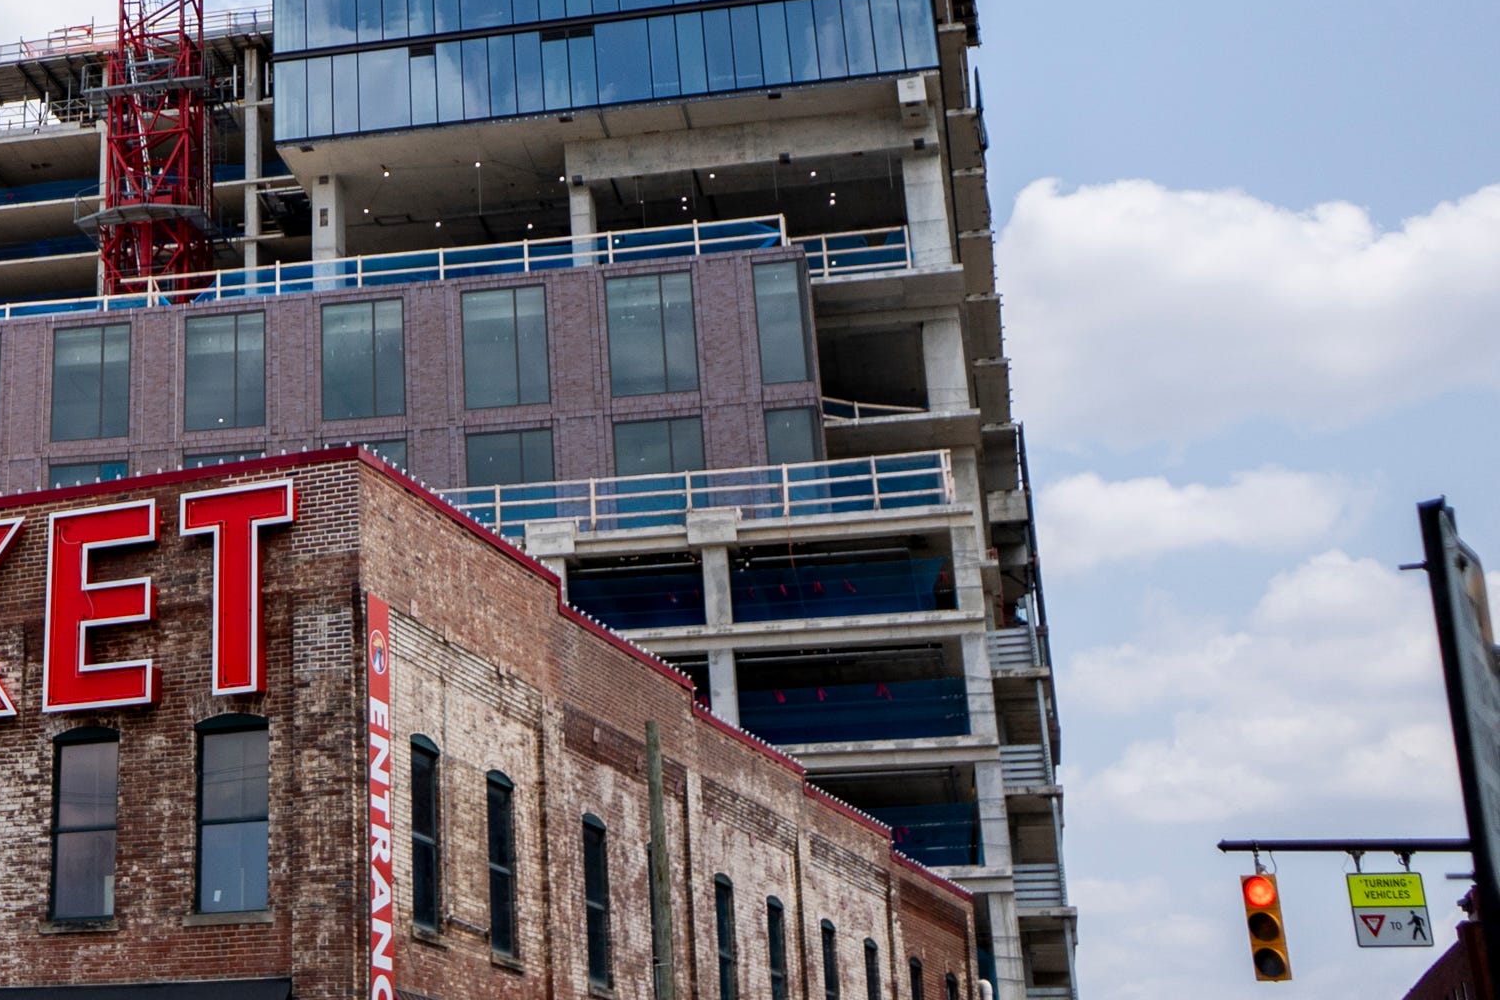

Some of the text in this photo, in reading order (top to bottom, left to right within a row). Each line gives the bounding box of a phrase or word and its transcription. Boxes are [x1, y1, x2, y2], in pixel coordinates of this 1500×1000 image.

[1364, 878, 1407, 888] TURNING
[1364, 890, 1410, 899] VEHICLES
[1390, 921, 1402, 930] TO
